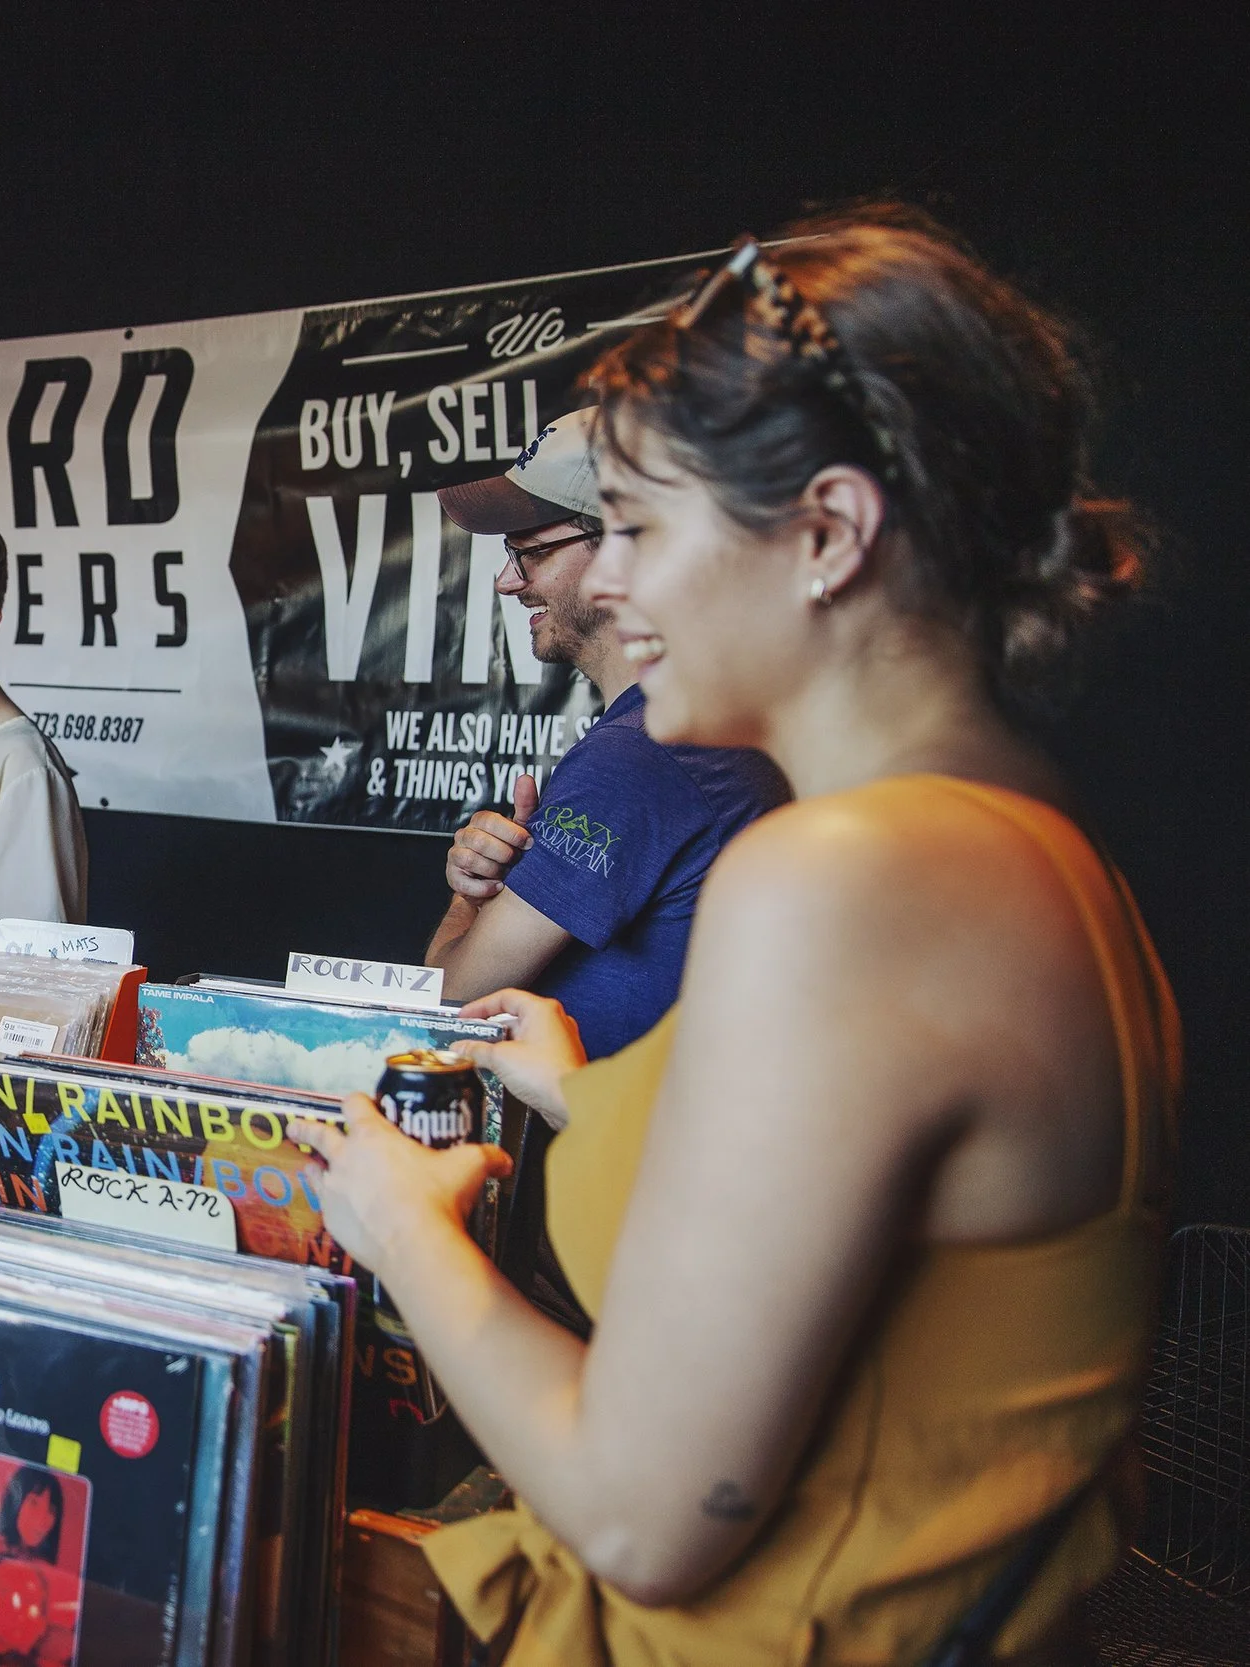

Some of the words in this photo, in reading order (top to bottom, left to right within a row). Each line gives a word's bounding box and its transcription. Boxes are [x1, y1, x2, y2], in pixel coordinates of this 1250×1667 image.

[486, 307, 565, 358] We
[299, 390, 413, 478] BUY,
[386, 710, 424, 751] WE
[425, 712, 493, 755] ALSO
[498, 714, 567, 757] HAVE
[366, 757, 387, 796] &
[394, 759, 486, 801] THINGS
[531, 820, 615, 879] MOUNTAIN
[545, 805, 621, 853] CRAZY
[291, 952, 373, 985] ROCK
[382, 965, 436, 993] N-Z
[141, 988, 172, 999] TAME
[173, 991, 215, 1004] IMPALA
[399, 1018, 498, 1037] INNERSPEAKER
[61, 1166, 149, 1204] ROCK
